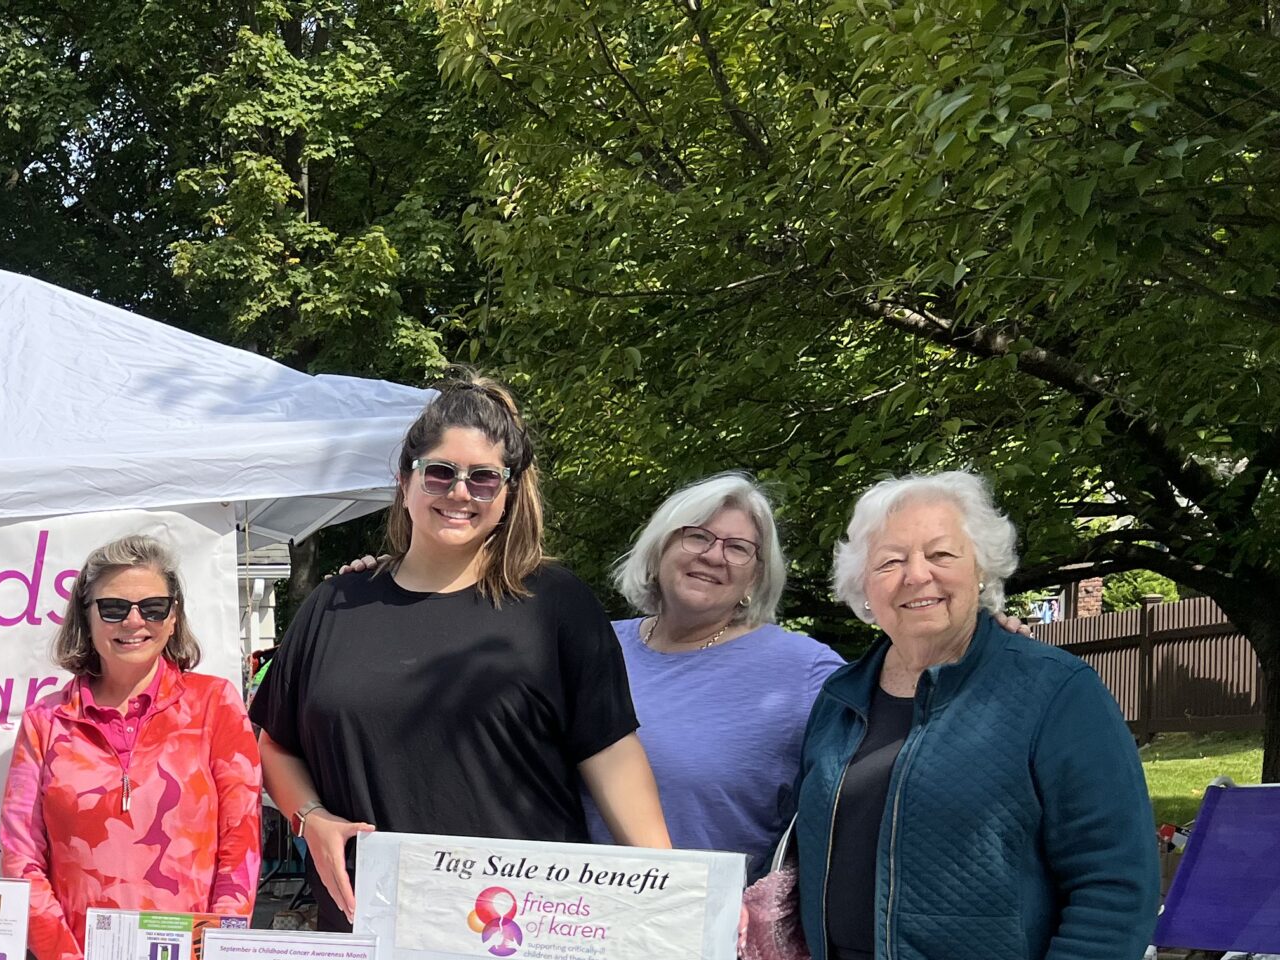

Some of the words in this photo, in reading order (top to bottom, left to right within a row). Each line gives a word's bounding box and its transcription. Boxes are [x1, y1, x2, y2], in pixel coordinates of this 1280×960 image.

[433, 850, 477, 880] Tag
[483, 855, 539, 880] Sale
[546, 863, 570, 882] to
[578, 862, 670, 894] benefit
[520, 892, 591, 916] friends
[526, 915, 548, 939] of
[548, 917, 608, 940] karen
[220, 946, 251, 954] September
[258, 947, 288, 955] Childhood
[523, 951, 553, 959] children
[554, 953, 567, 960] and
[528, 942, 567, 953] supporting
[568, 944, 606, 955] critically-ill
